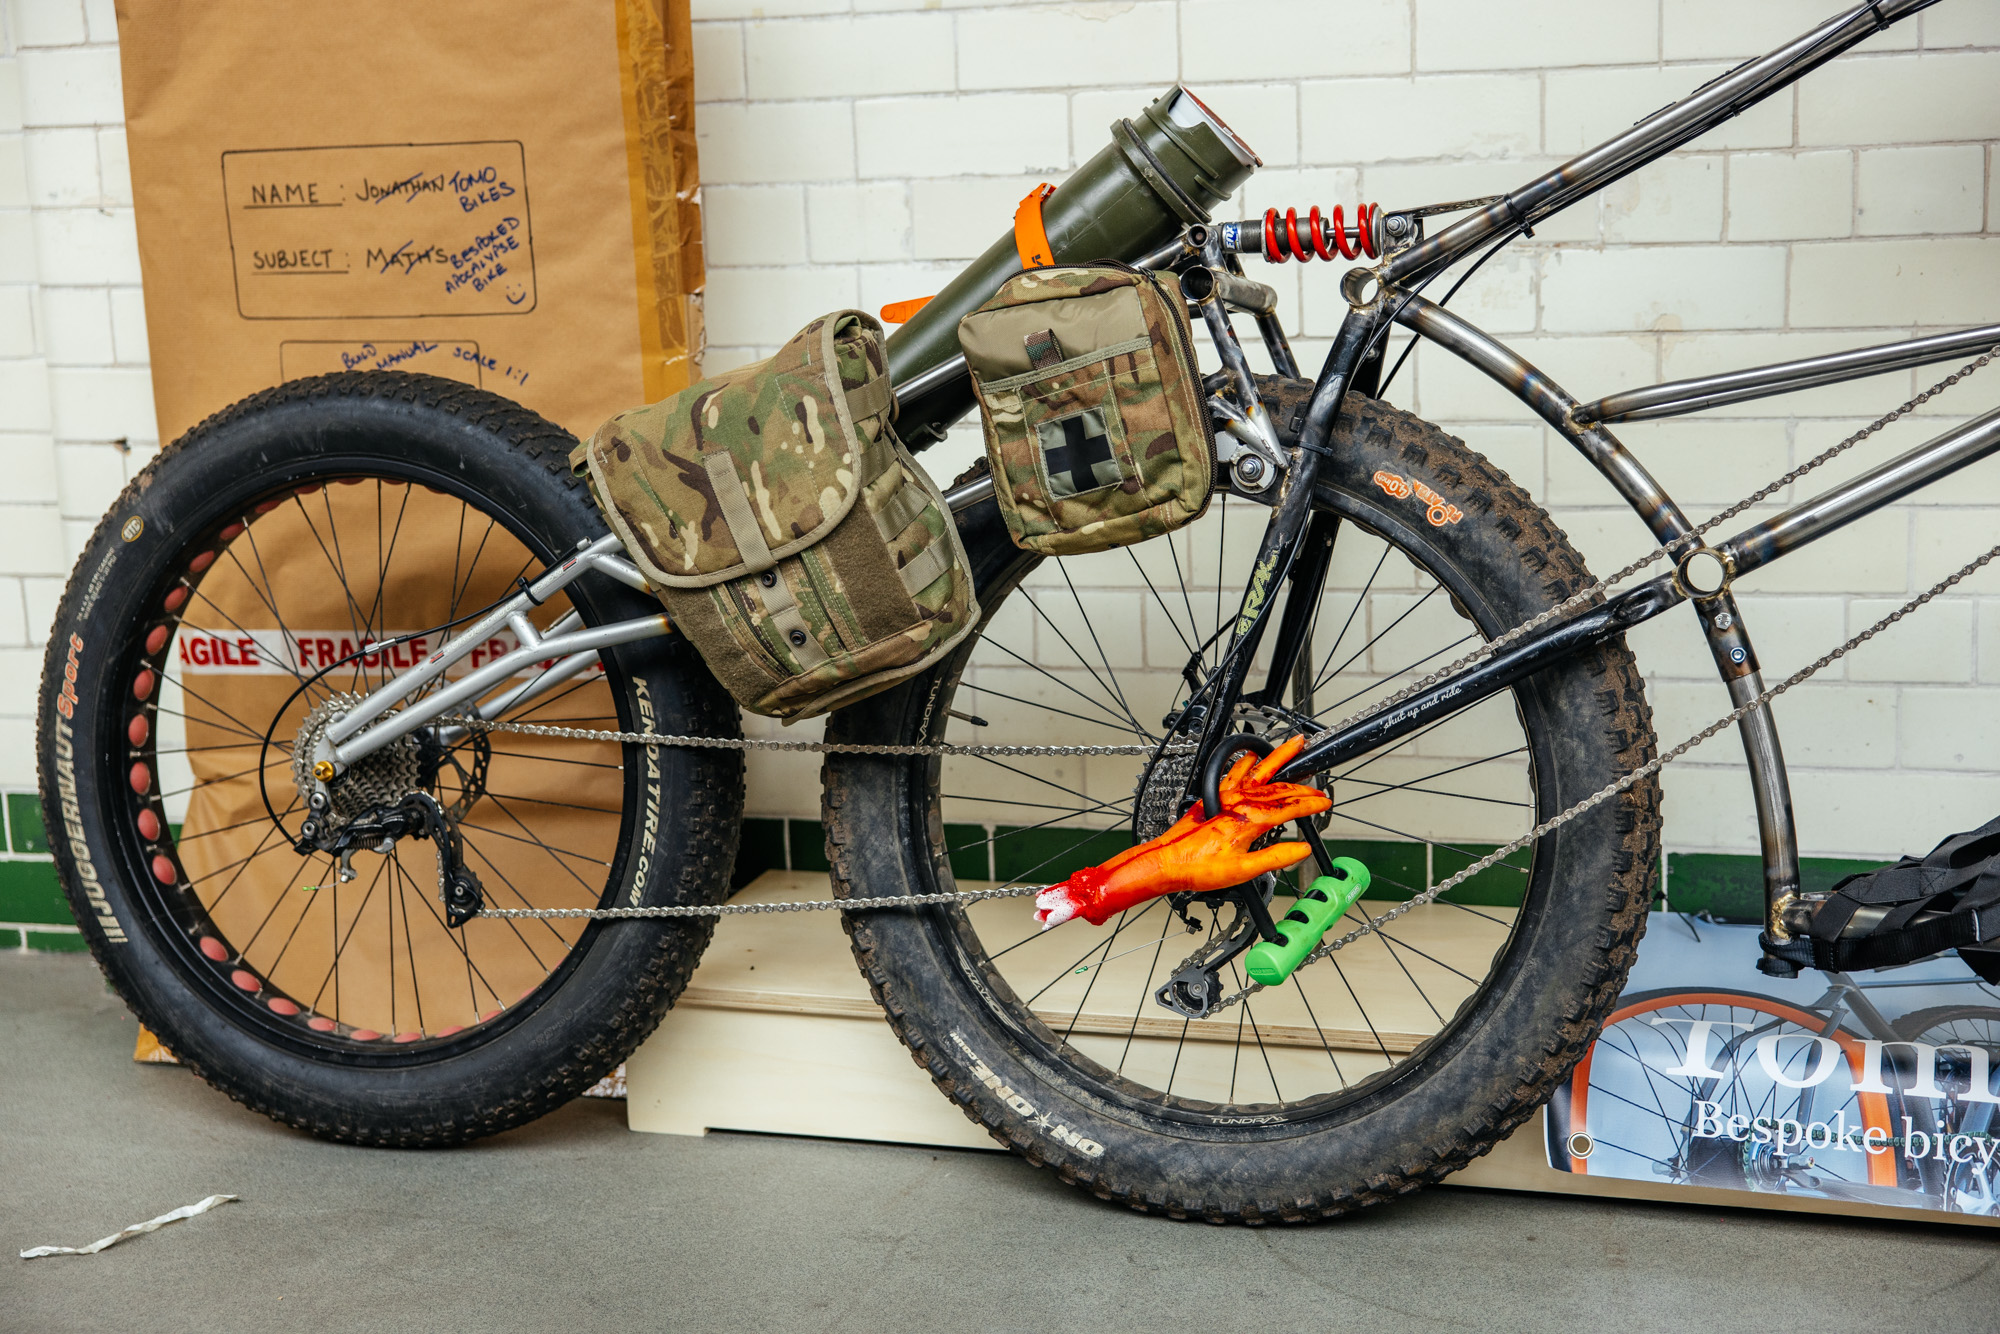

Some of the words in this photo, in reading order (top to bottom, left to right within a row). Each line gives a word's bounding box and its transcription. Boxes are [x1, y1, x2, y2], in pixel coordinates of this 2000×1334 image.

[251, 183, 319, 204] NAME
[355, 174, 444, 202] JONATHAN
[449, 166, 497, 194] TOMO
[459, 181, 516, 213] BIKES
[450, 216, 520, 270] BESPOKED
[253, 249, 333, 270] SUBJECT
[445, 235, 520, 294] APOCALYPSE
[472, 263, 508, 293] BIKE
[341, 342, 377, 370] BUILD
[375, 341, 439, 371] MANUAL
[452, 346, 498, 371] SCALE
[56, 632, 84, 720] Sport
[918, 677, 943, 747] TUNDRA
[1406, 707, 1421, 719] up
[1420, 693, 1440, 711] and
[55, 714, 114, 913] JUGGERNAUT
[629, 783, 662, 908] TIRE.COM
[1650, 1017, 2000, 1105] Tom
[1210, 1115, 1289, 1125] TUNDRA
[1691, 1099, 1888, 1157] Bespoke
[1900, 1115, 2000, 1175] bicy
